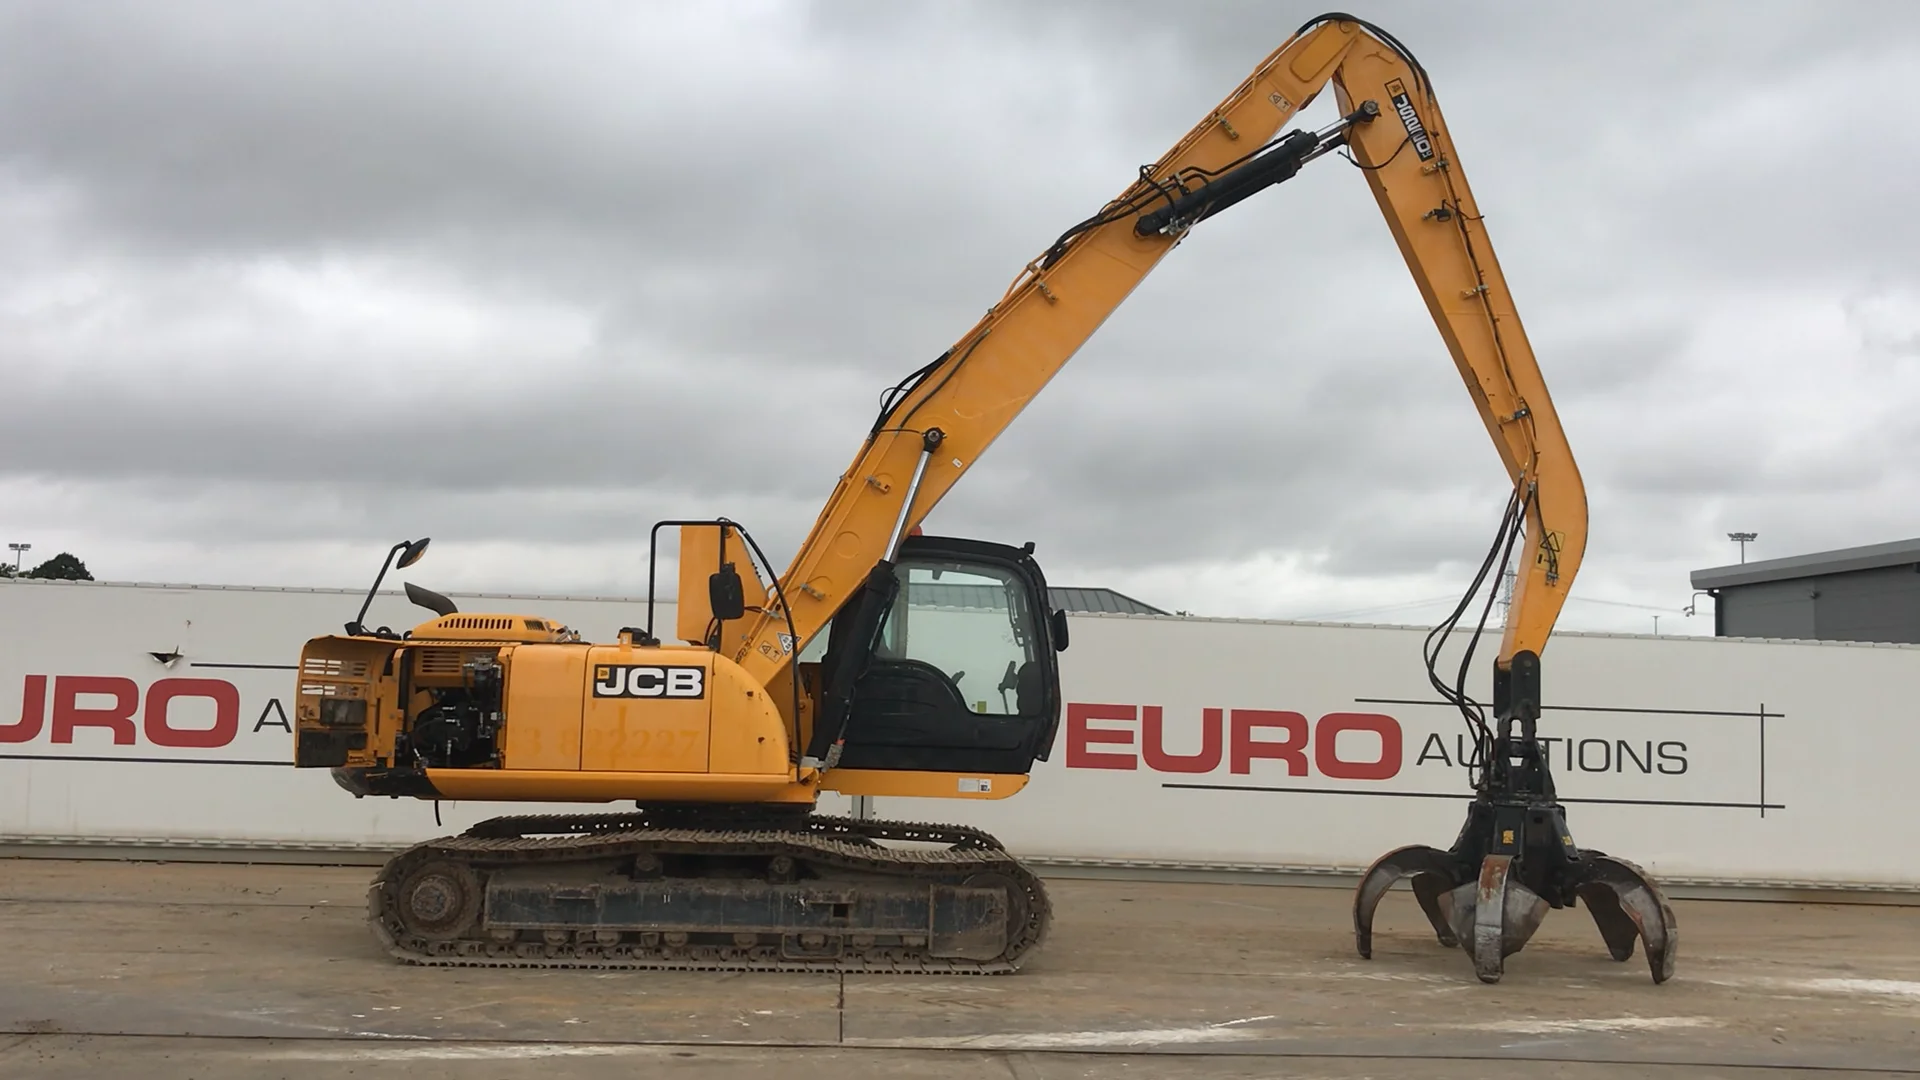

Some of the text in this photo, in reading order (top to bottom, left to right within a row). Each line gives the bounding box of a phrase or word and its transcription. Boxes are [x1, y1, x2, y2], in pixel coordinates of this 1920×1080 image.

[597, 667, 702, 696] JCB
[1066, 703, 1688, 780] EURO AUTIONS
